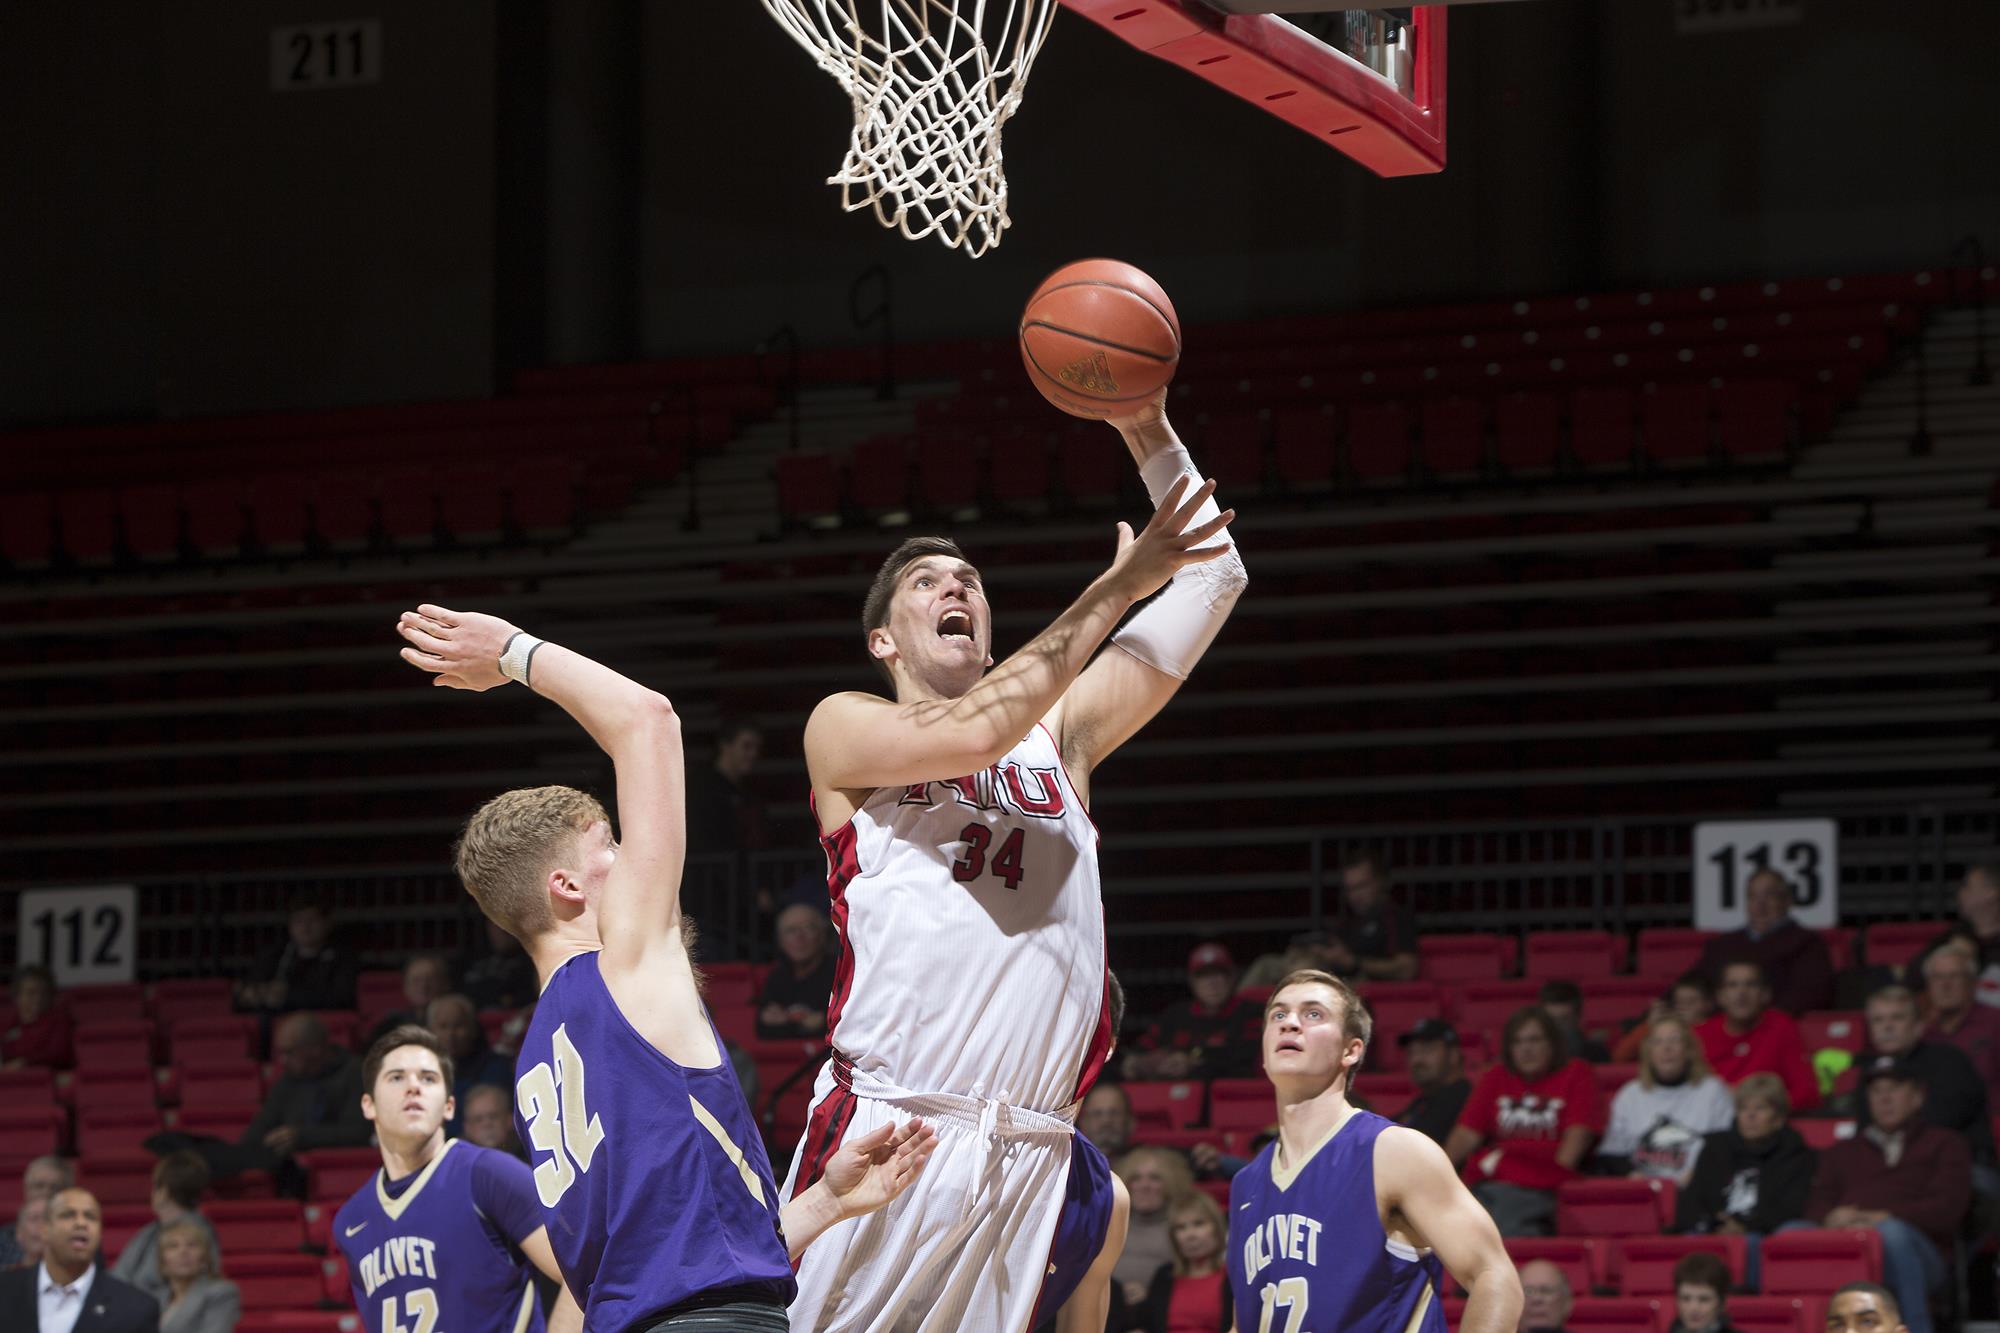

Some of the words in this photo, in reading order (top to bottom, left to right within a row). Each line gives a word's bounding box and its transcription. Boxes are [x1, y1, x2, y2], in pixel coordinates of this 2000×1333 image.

[290, 32, 362, 80] 211
[952, 822, 1025, 890] 34
[33, 906, 122, 966] 112
[516, 1022, 606, 1209] 32
[358, 1235, 438, 1299] OLIVET
[1243, 1211, 1322, 1286] OLIVET
